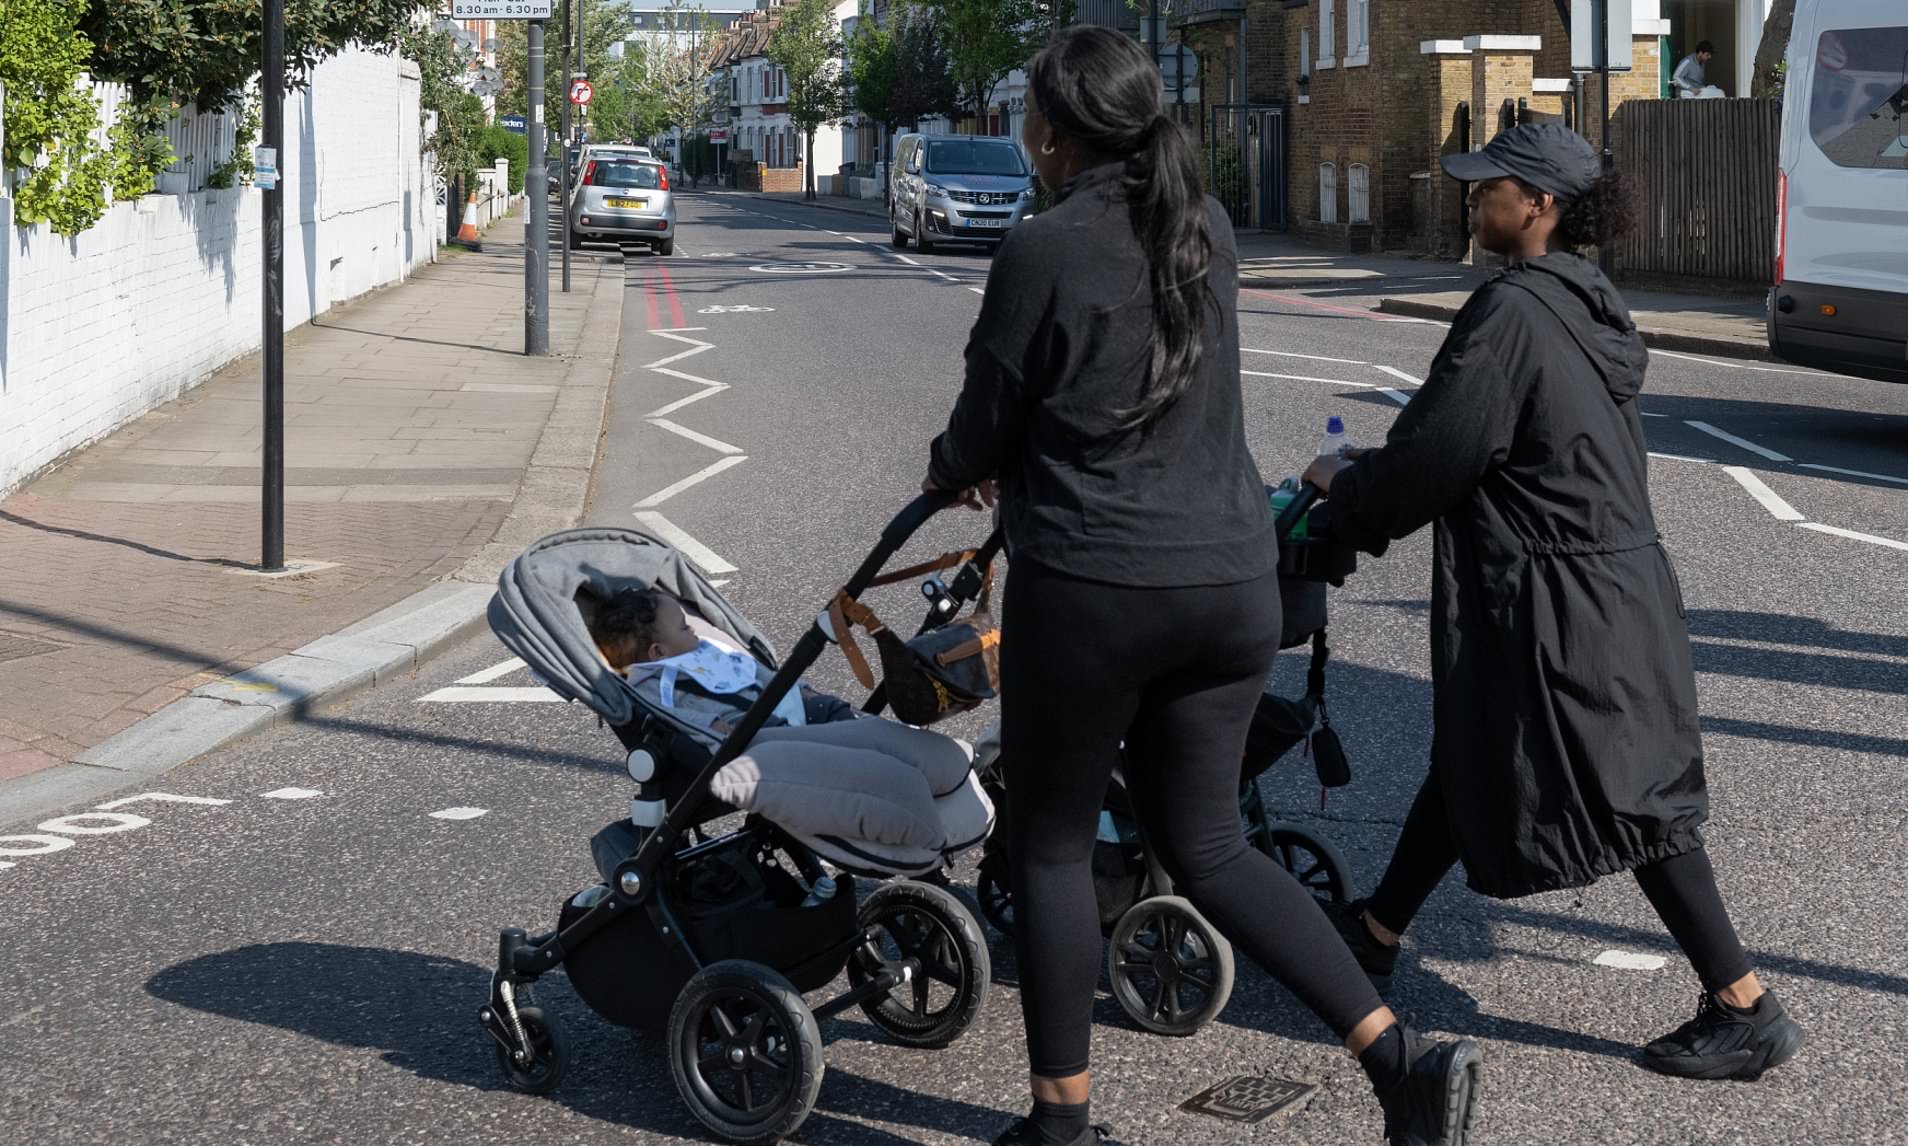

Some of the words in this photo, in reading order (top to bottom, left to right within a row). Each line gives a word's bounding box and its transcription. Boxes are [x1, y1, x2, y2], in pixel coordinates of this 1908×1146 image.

[455, 5, 481, 14] 8.30
[505, 5, 531, 14] 6.30
[533, 6, 548, 15] pm
